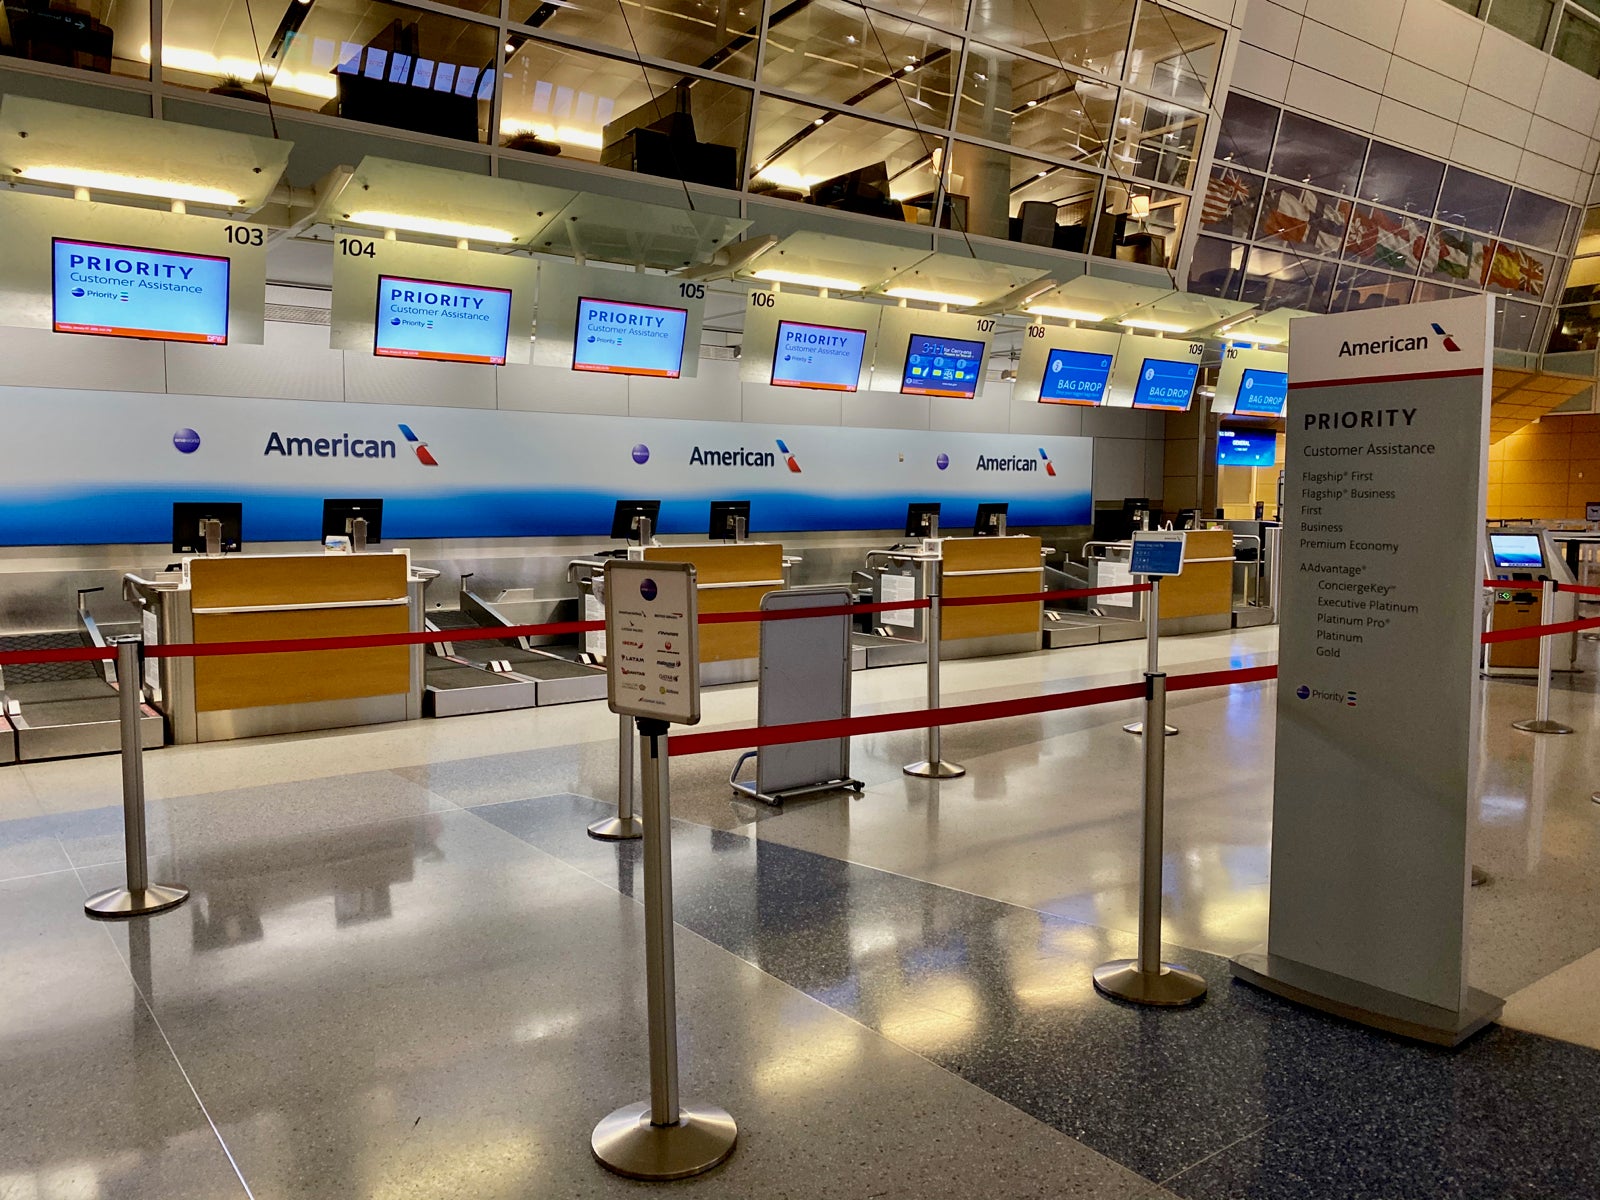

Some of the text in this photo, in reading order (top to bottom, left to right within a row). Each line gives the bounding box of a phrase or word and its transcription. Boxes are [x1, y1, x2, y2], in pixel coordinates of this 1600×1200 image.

[224, 225, 264, 246] 103
[339, 238, 376, 258] 104
[70, 254, 194, 280] PRIORITY
[70, 272, 203, 294] Customer Assistance
[87, 290, 118, 300] Priority
[679, 282, 705, 299] 105
[391, 289, 483, 310] PRIORITY
[751, 292, 775, 307] 106
[390, 304, 490, 322] Customer Assistance
[588, 309, 664, 328] PRIORITY
[402, 319, 425, 328] Priority
[976, 319, 995, 332] 107
[587, 323, 669, 339] Customer Assistance
[1028, 325, 1045, 338] 108
[786, 331, 847, 347] PRIORITY
[1338, 335, 1428, 357] American
[785, 343, 850, 357] Customer Assistance
[1188, 344, 1203, 355] 109
[1226, 348, 1238, 359] 110
[1057, 379, 1102, 392] BAG DROP
[1149, 386, 1188, 398] BAG DROP
[1248, 394, 1282, 405] BAG DROP
[1304, 408, 1417, 430] PRIORITY
[264, 432, 396, 458] American
[1303, 443, 1436, 457] Customer Assistance
[689, 446, 774, 467] American
[976, 454, 1037, 472] American
[1351, 471, 1373, 481] First
[1351, 488, 1396, 499] Business
[1301, 505, 1322, 515] First
[1300, 522, 1343, 533] Business
[1300, 538, 1399, 555] Premium Economy
[1318, 596, 1419, 614] Executive Platinum
[1317, 613, 1363, 626] Platinum
[1316, 629, 1363, 643] Platinum
[625, 655, 645, 663] LATAM
[1316, 646, 1341, 658] Gold
[1312, 689, 1344, 703] Priority
